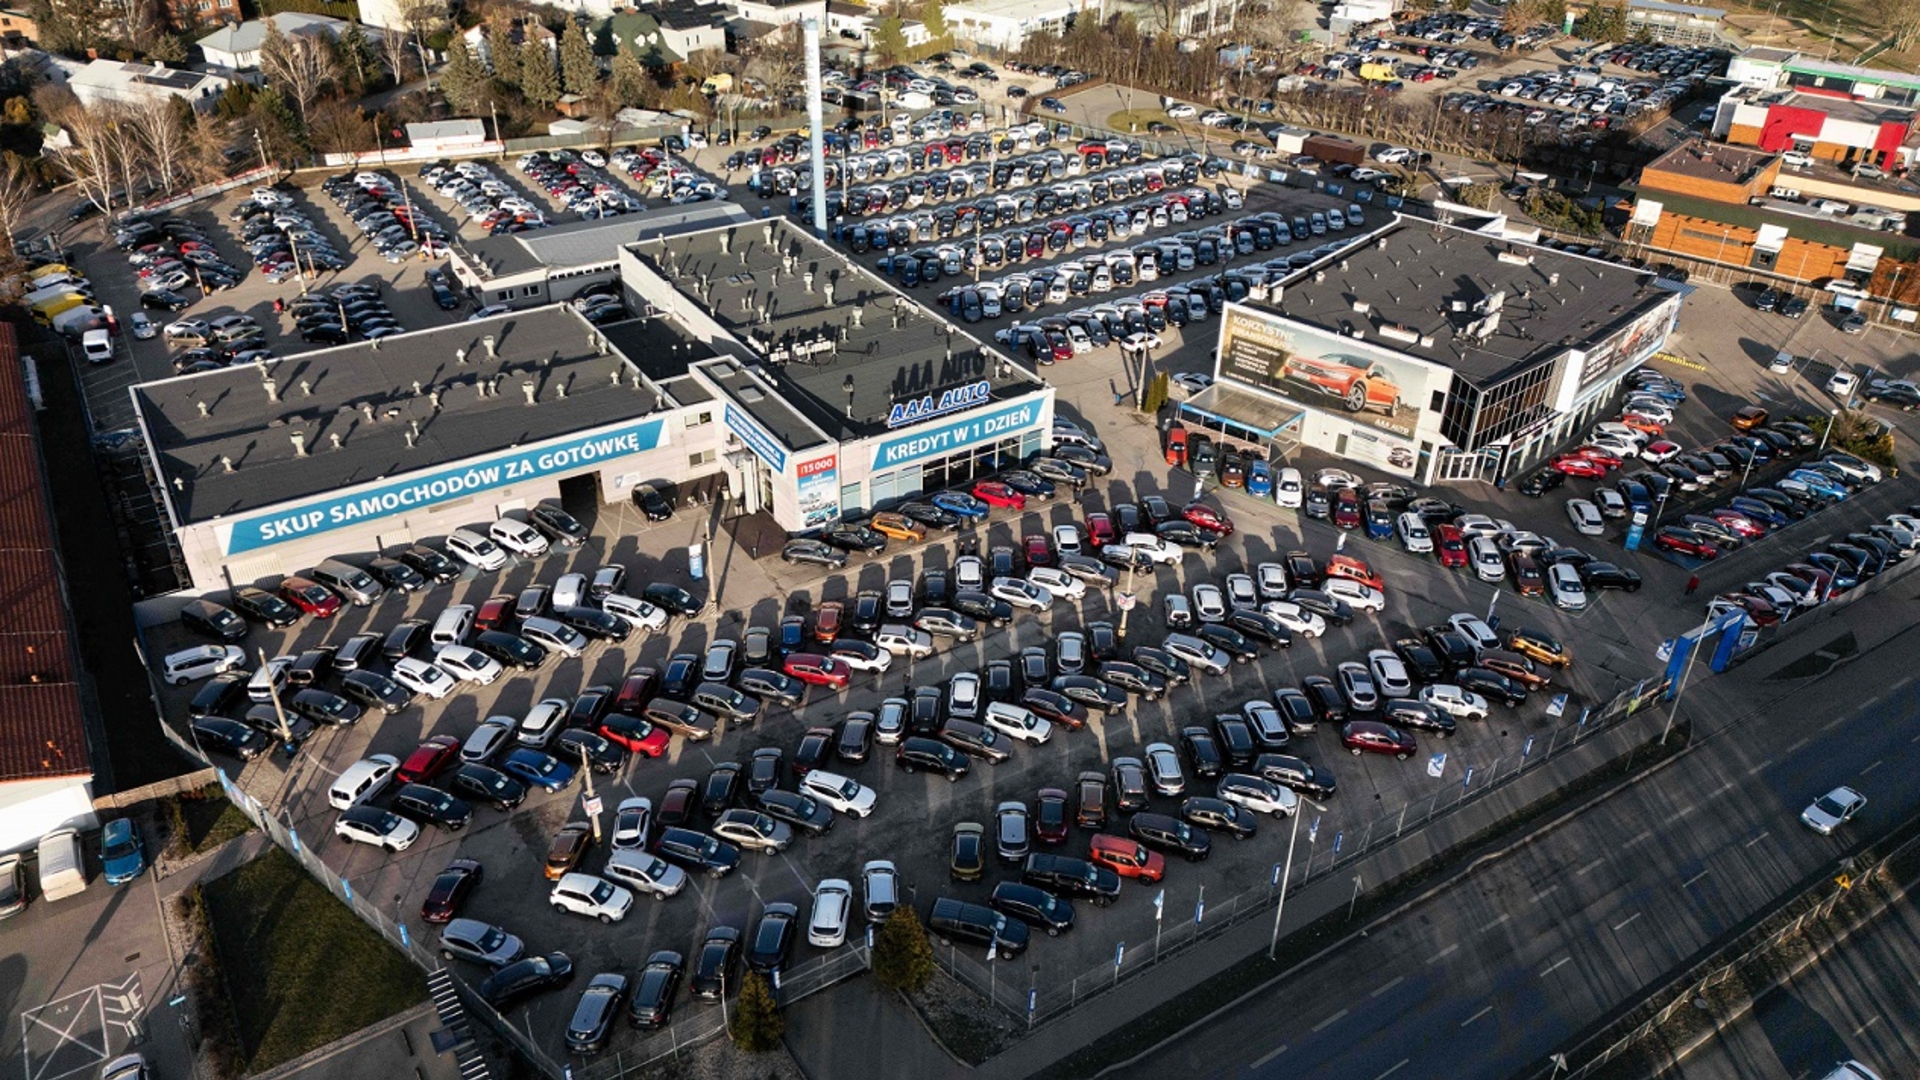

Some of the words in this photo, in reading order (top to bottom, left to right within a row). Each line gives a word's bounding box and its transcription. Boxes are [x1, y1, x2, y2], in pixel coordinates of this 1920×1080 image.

[890, 402, 933, 422] AAA
[940, 381, 990, 409] AUTO
[886, 431, 950, 462] KREDYT
[953, 426, 969, 443] W
[973, 425, 980, 437] 1
[985, 405, 1030, 434] DZIEŃ
[260, 510, 324, 540] SKUP
[329, 466, 500, 523] SAMOCHODÓW
[504, 459, 535, 479] ZA
[538, 432, 640, 470] GOTÓWKĘ
